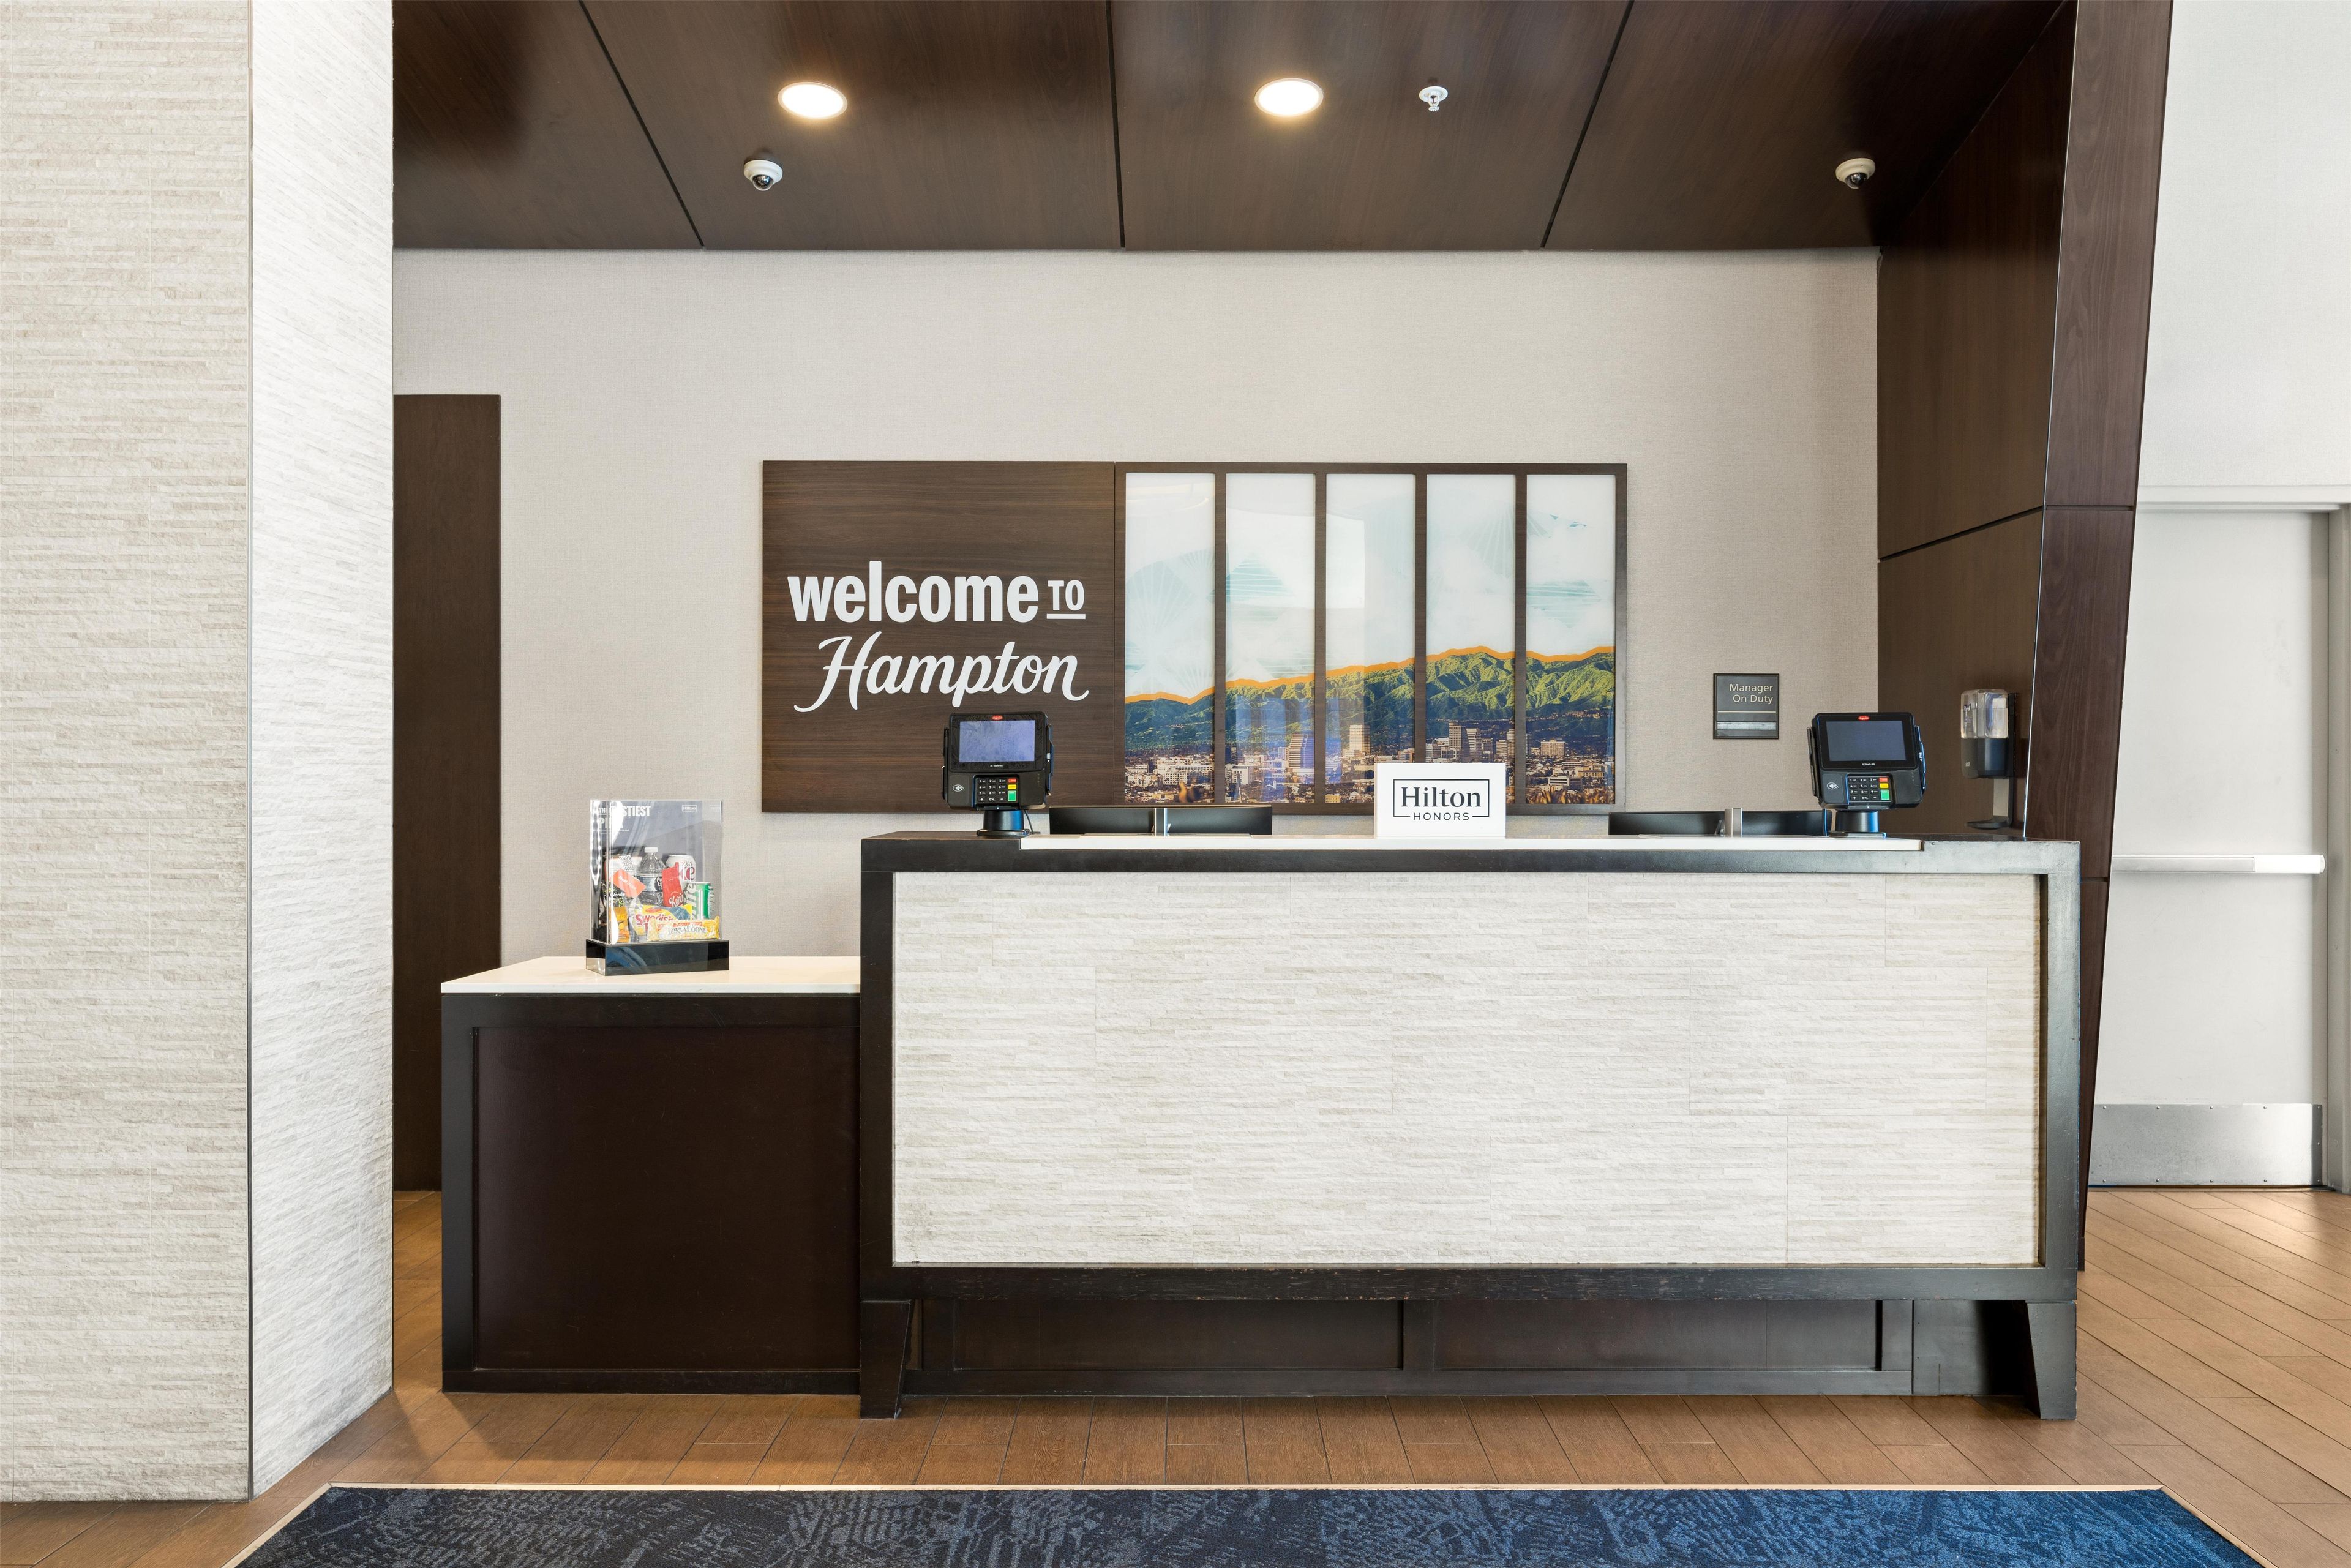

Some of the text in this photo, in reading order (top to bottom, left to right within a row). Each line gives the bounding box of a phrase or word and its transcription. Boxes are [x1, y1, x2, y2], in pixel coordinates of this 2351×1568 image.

[787, 561, 1085, 623] welcome TO
[793, 631, 1090, 713] Hampton
[1730, 683, 1773, 694] Manager
[1733, 694, 1773, 705] On Duty
[1401, 787, 1482, 808] Hilton
